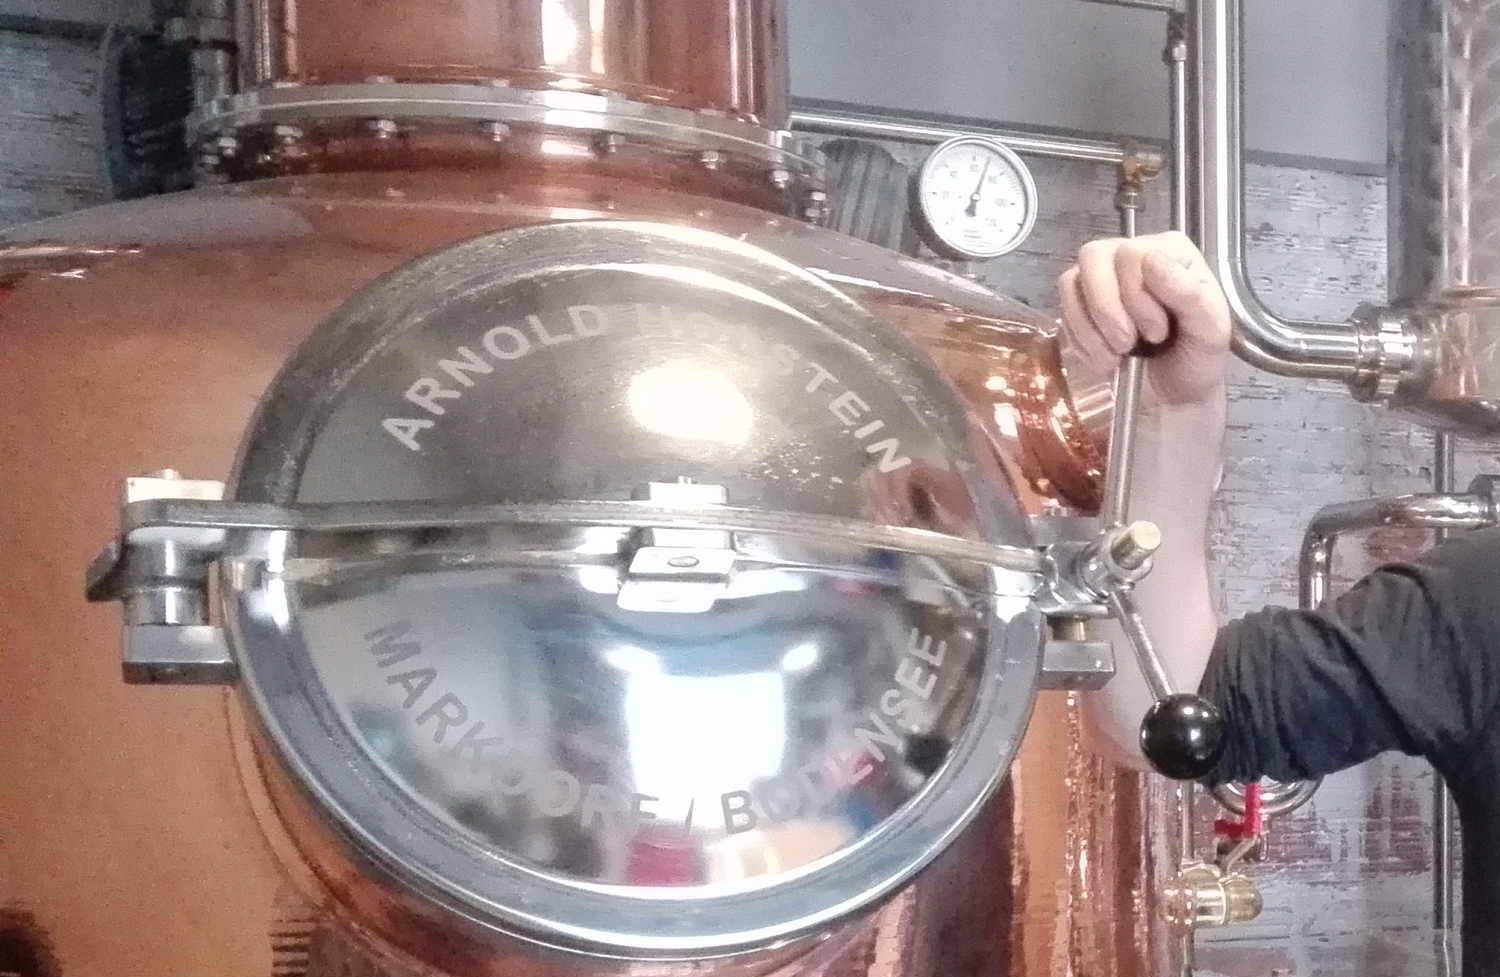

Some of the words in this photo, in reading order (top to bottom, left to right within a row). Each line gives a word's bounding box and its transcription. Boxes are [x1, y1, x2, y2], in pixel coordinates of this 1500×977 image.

[381, 302, 609, 452] ARNOLD
[636, 303, 913, 475] HOSTEIN
[720, 626, 948, 835] BODENSEE
